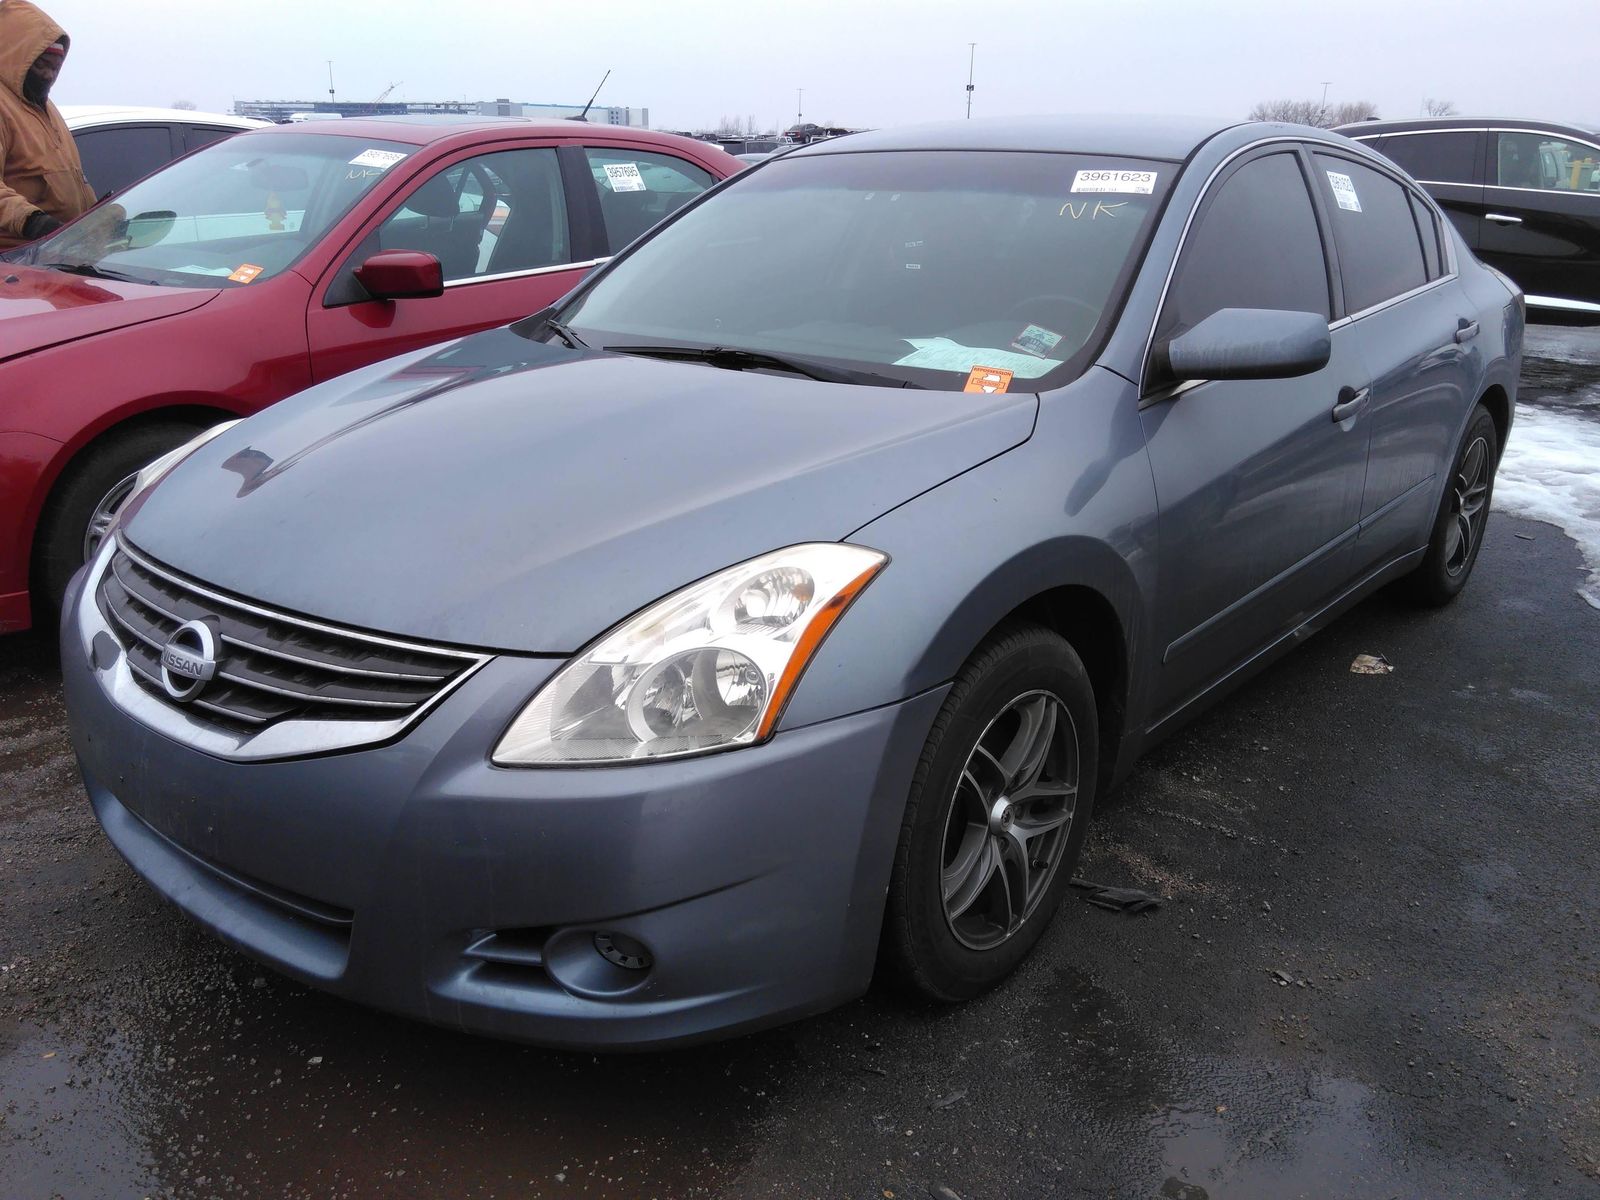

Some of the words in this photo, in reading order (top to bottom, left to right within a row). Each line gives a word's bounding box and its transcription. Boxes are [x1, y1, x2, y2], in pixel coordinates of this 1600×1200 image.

[606, 166, 639, 178] 3957695
[1079, 172, 1152, 182] 3961623
[1059, 200, 1129, 219] NK
[973, 367, 1012, 377] REPOSSESSION
[162, 647, 204, 676] NISSAN
